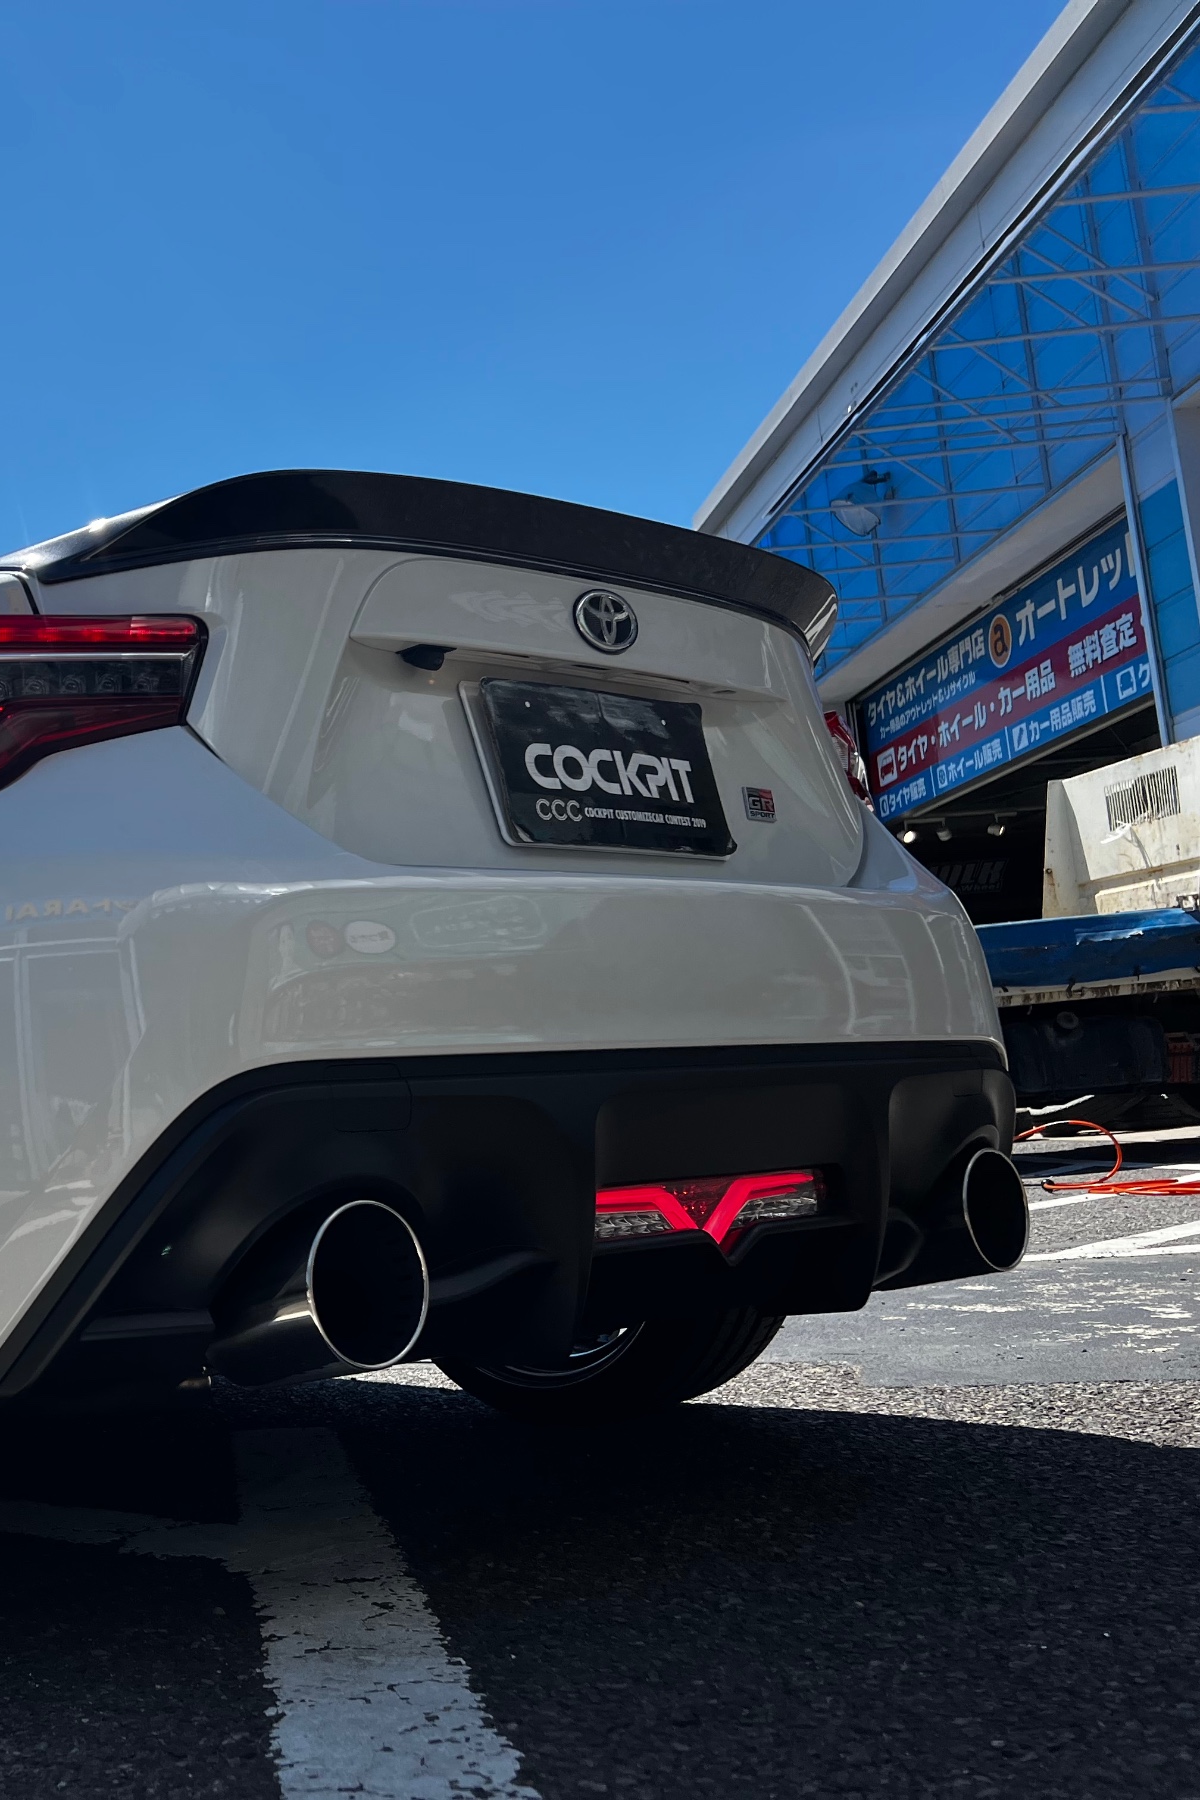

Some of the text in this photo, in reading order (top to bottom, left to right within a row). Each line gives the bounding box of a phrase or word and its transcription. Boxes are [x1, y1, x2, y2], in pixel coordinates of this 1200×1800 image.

[1068, 612, 1137, 678] 無料査定
[1029, 690, 1097, 743] カー用品販売
[524, 742, 695, 804] COCKPIT
[947, 738, 1003, 782] ホイール販売
[535, 798, 583, 822] CCC
[584, 807, 615, 819] COCKPIT
[665, 814, 692, 827] CONTEST
[748, 796, 774, 812] GR
[750, 811, 775, 819] SPORT
[889, 777, 926, 813] タイヤ販売
